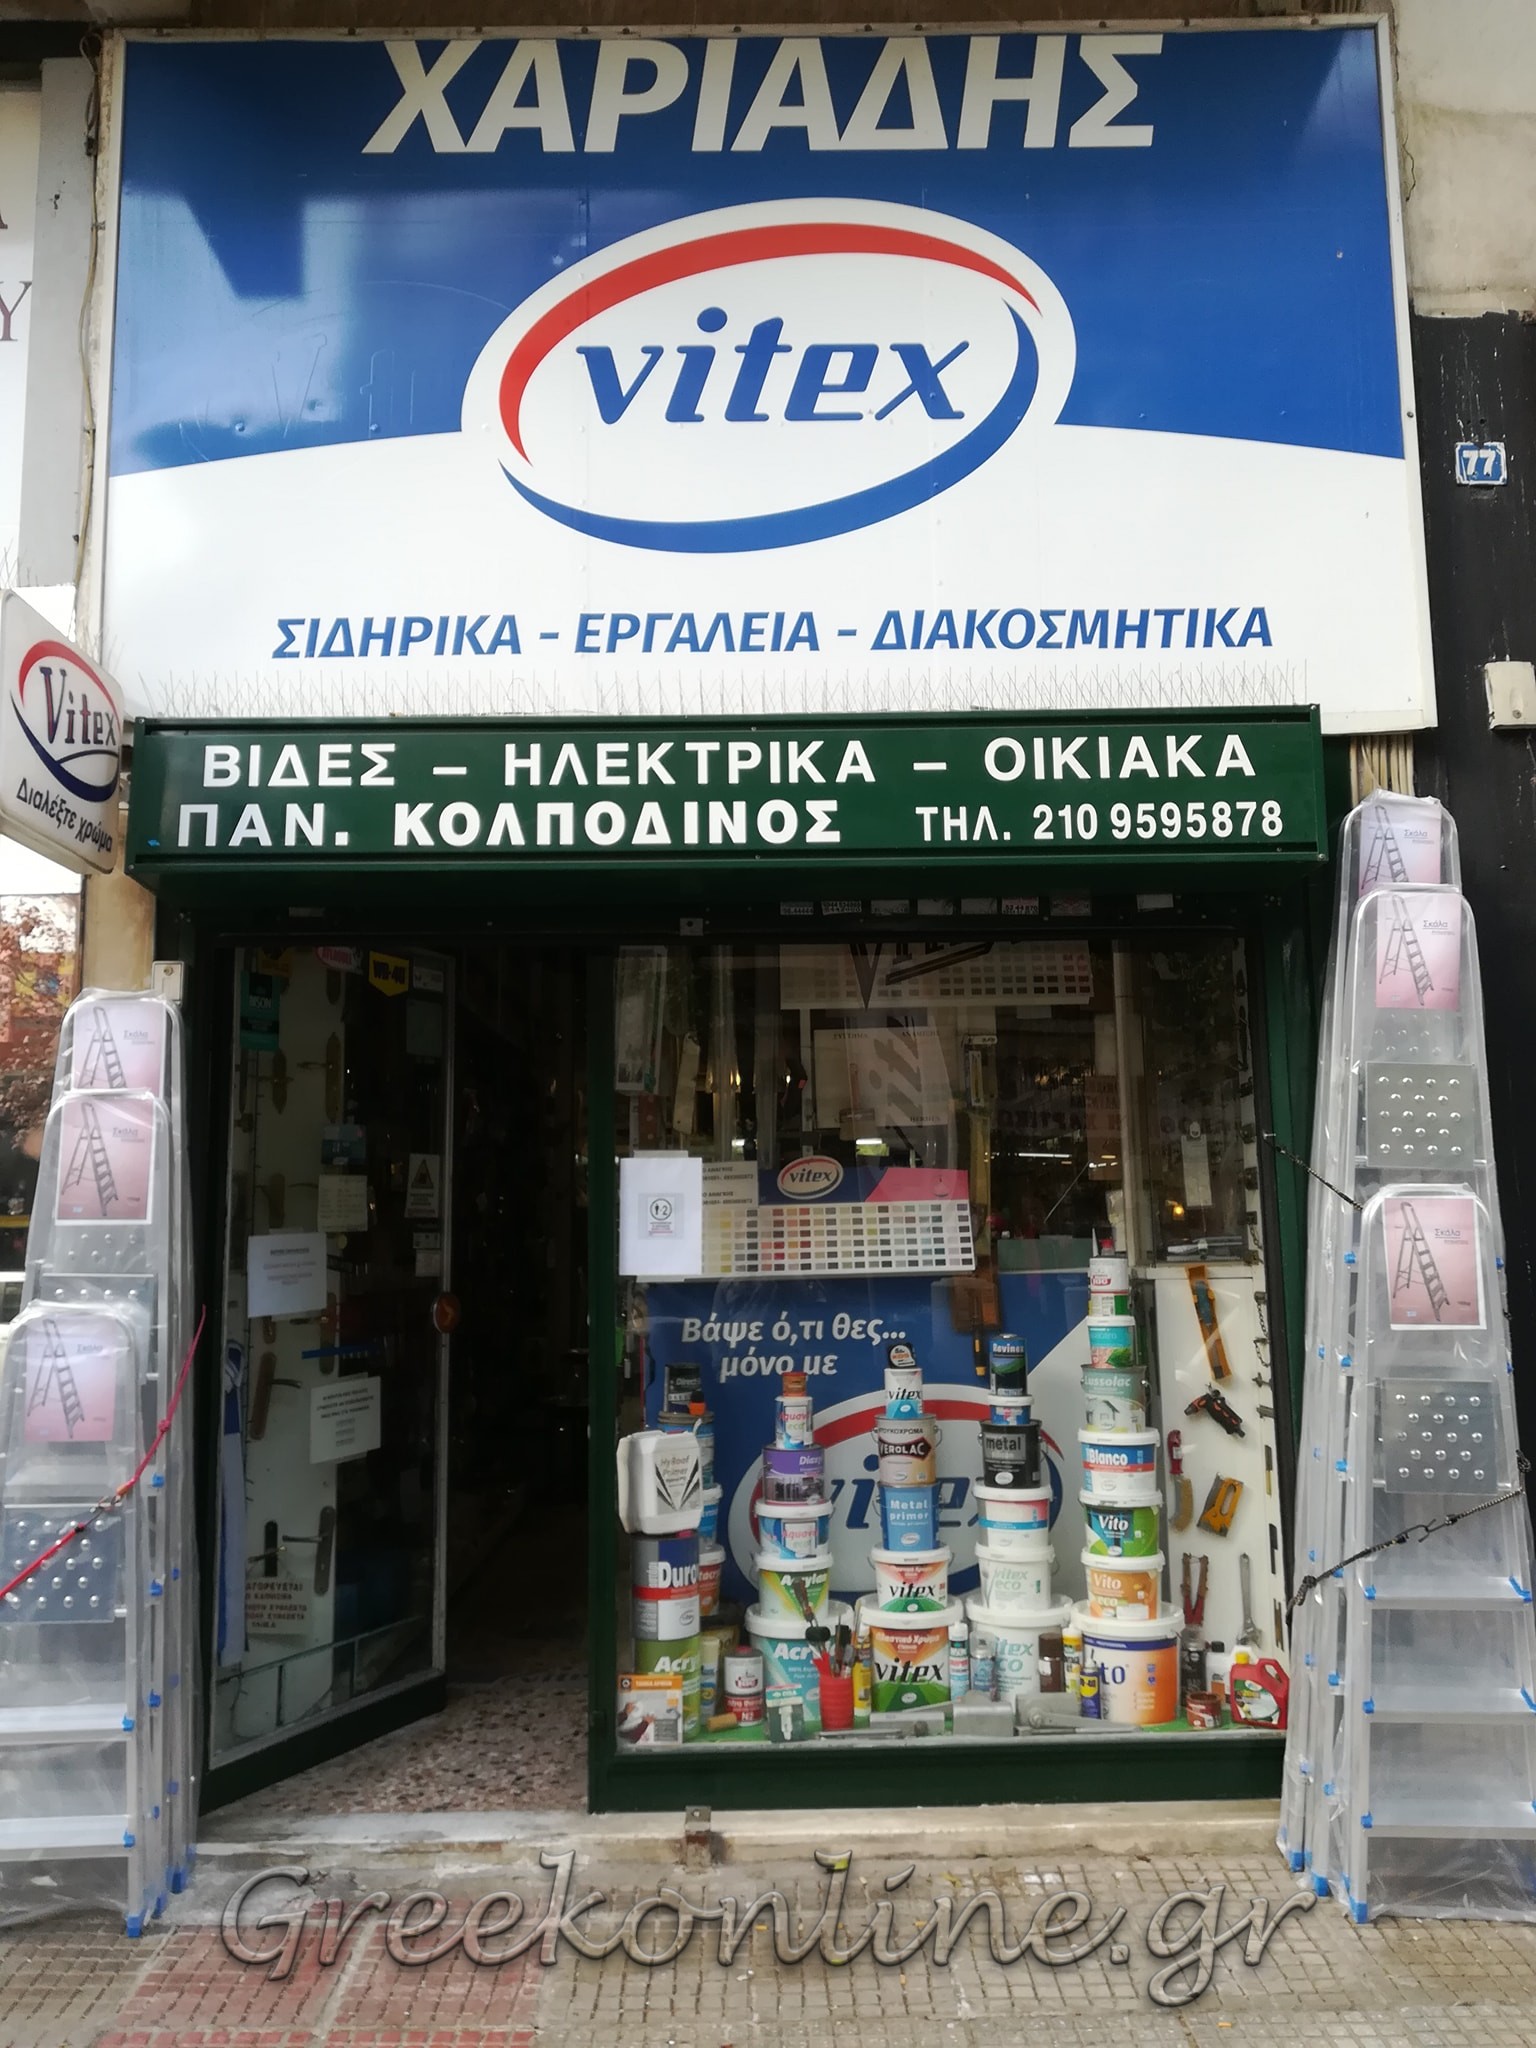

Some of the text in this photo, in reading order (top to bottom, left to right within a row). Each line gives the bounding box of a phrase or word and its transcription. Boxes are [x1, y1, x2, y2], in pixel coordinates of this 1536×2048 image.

[361, 35, 1162, 153] ΧΑΡΙΑΔΗΣ
[576, 307, 969, 424] vitex
[1462, 449, 1496, 477] 77
[272, 614, 522, 658] ΣΙΔΗΡΙΚΑ
[574, 611, 820, 654] ΕΡΓΑΛΕΙΑ
[870, 607, 1274, 651] ΔΙΑΚΟΣΜΗΤΙΚΑ
[37, 667, 117, 746] Vitex
[203, 743, 396, 787] ΒΙΔΕΣ
[504, 740, 876, 786] ΗΛΕΚΤΡΙΚΑ
[984, 734, 1256, 782] ΟΙΚΙΑΚΑ
[16, 778, 113, 853] Διαλέξτε χρώμα
[178, 798, 1284, 847] ΠΑΝ. ΚΟΛΠΟΔΙΝΟΣ ΤΗΛ. 210 9595878
[789, 1168, 833, 1184] vitex
[681, 1311, 907, 1348] Βάψε ό,τι θες...
[719, 1346, 839, 1384] μόνο με
[887, 1388, 922, 1401] vitex
[985, 1436, 1021, 1451] metal
[1098, 1515, 1129, 1531] Vito
[888, 1582, 936, 1598] vitex
[1092, 1573, 1122, 1590] Vito
[875, 1656, 943, 1683] vitex
